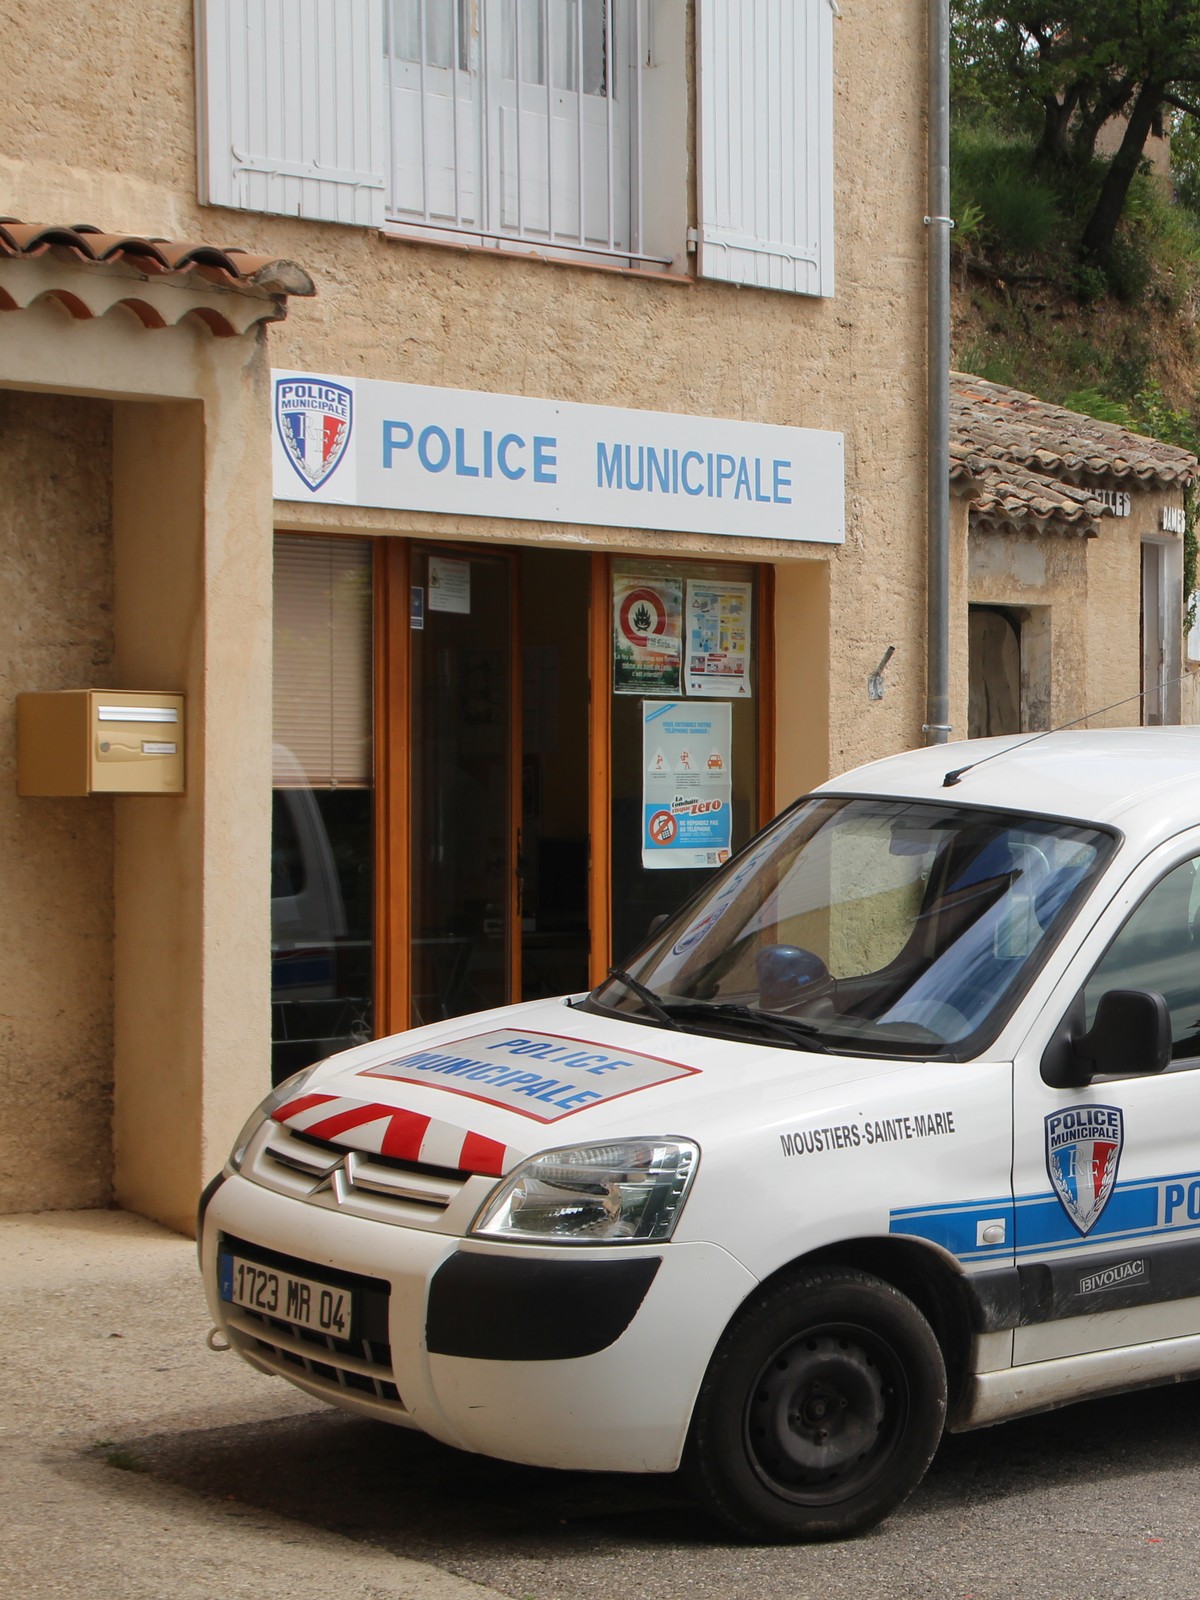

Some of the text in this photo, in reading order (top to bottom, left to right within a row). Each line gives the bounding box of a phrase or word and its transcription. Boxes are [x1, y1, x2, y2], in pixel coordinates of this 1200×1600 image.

[281, 399, 347, 417] MUNICIPALE
[282, 385, 347, 407] POLICE
[382, 420, 792, 504] POLICE MUNICIPALE
[1163, 506, 1185, 533] DAMES
[485, 1038, 634, 1075] POLICE
[390, 1053, 602, 1110] MUNICIPALE
[779, 1111, 955, 1157] MOUSTIERS-SAINTE-MARIE
[1049, 1110, 1118, 1135] POLICE
[1051, 1127, 1118, 1147] MUNICIPALE
[1081, 1259, 1144, 1293] BIVOUAC
[238, 1264, 345, 1333] 1723 MR 04
